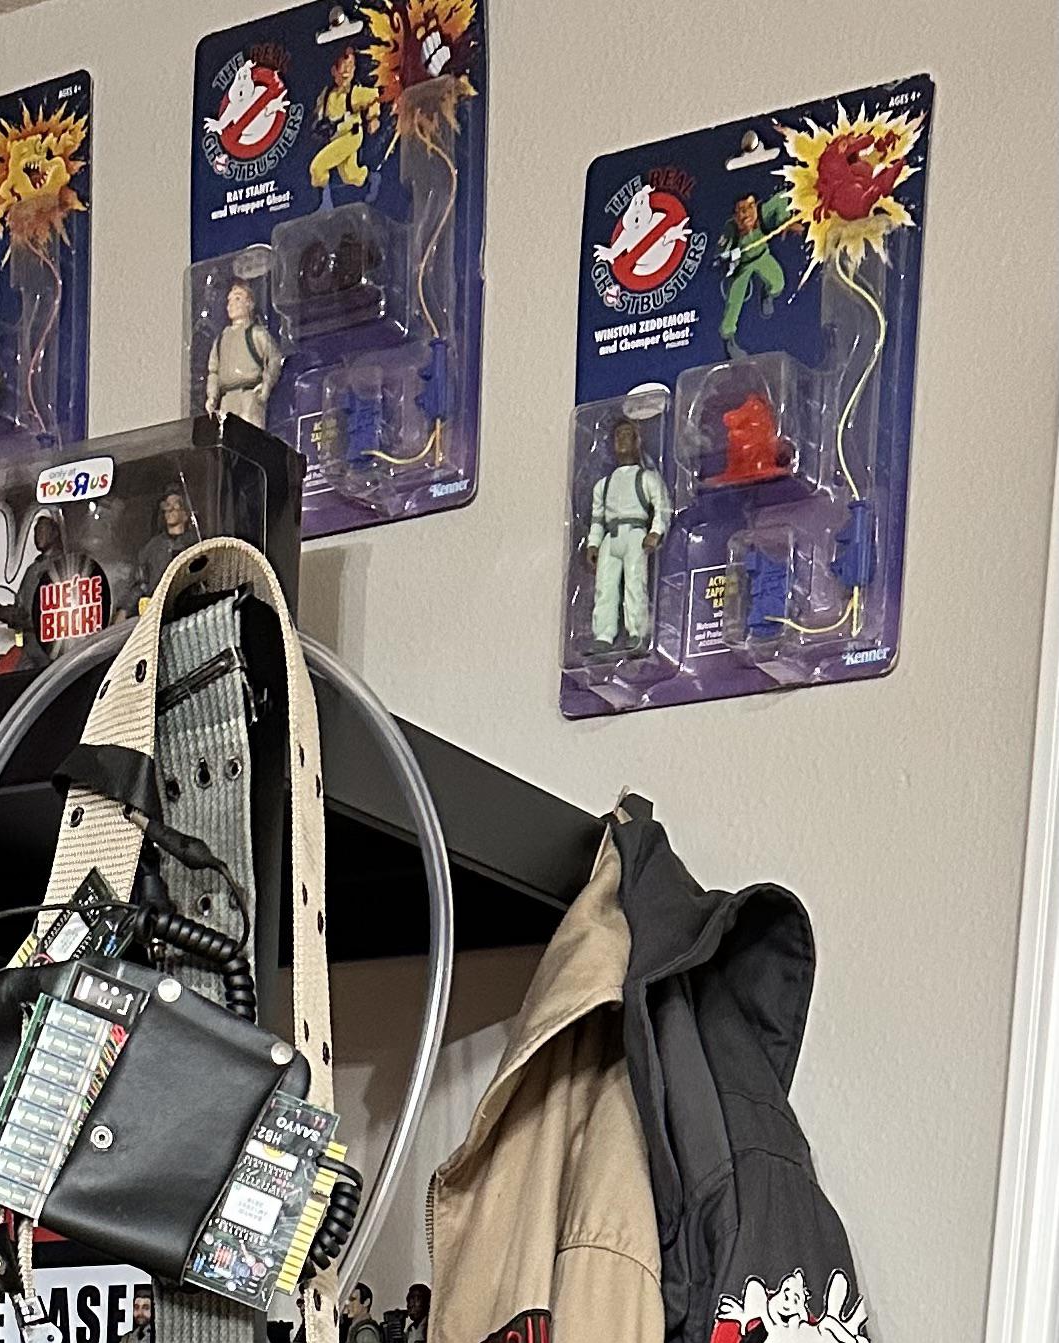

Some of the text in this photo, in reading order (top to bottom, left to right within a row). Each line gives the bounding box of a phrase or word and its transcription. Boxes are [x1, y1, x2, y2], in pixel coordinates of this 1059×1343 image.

[226, 189, 245, 203] RAY
[605, 174, 643, 216] THE
[591, 232, 708, 315] GHOSTBUSTERS
[594, 309, 696, 343] WINSTON ZEDDEMORE
[599, 326, 690, 356] and Chomper Ghost
[429, 479, 471, 498] Kenner
[40, 573, 103, 613] WE'RE
[40, 605, 103, 643] BACK!
[842, 646, 891, 666] Kenner
[276, 1116, 321, 1142] SANYO
